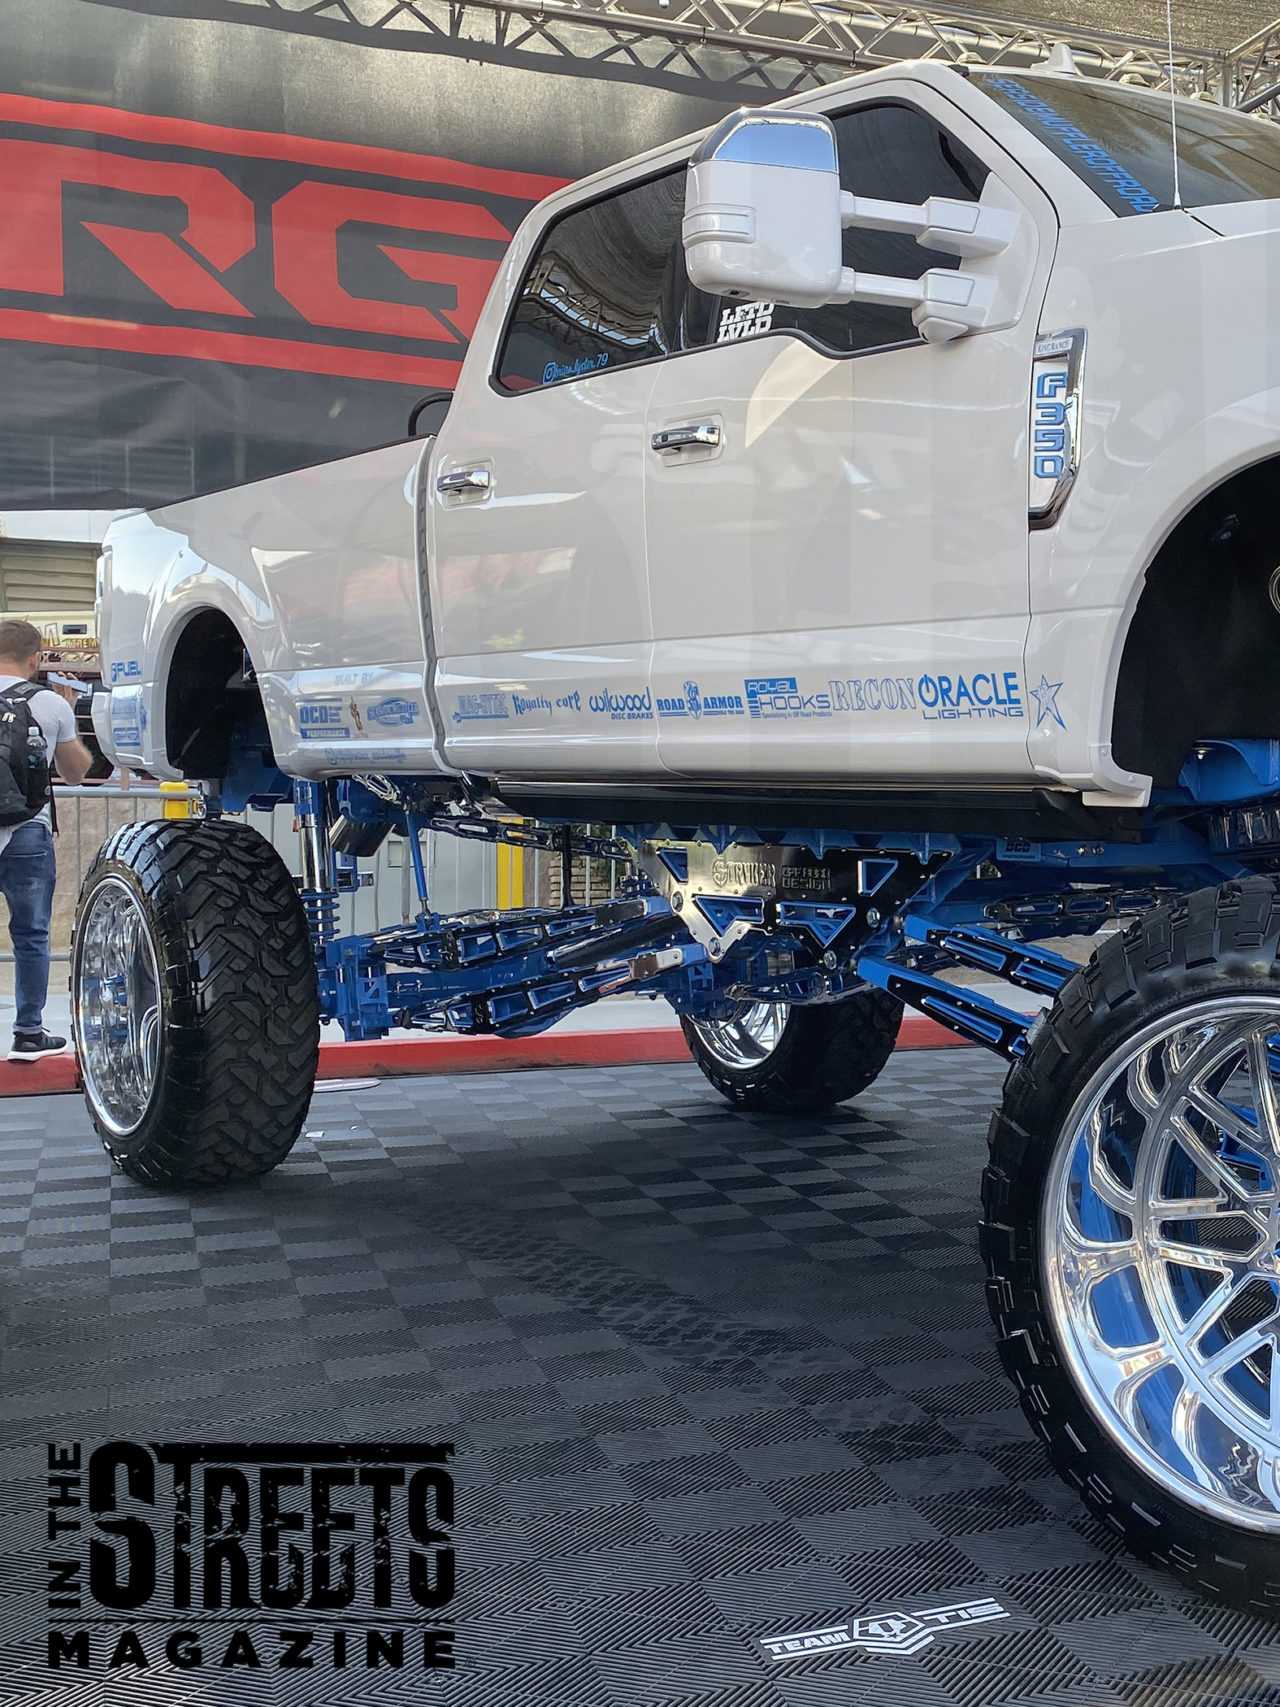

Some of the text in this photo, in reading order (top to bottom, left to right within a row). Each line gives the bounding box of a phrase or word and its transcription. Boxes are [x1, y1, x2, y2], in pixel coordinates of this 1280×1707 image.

[589, 686, 652, 713] wilwood
[828, 678, 917, 711] RECON
[918, 672, 1021, 708] ORACLE
[656, 696, 743, 711] ROAD ARMOR
[759, 694, 831, 711] HOOKS
[922, 707, 1024, 720] LIGHTING
[611, 711, 653, 720] DISC BRAKES
[764, 1602, 1004, 1654] TEAM TIS
